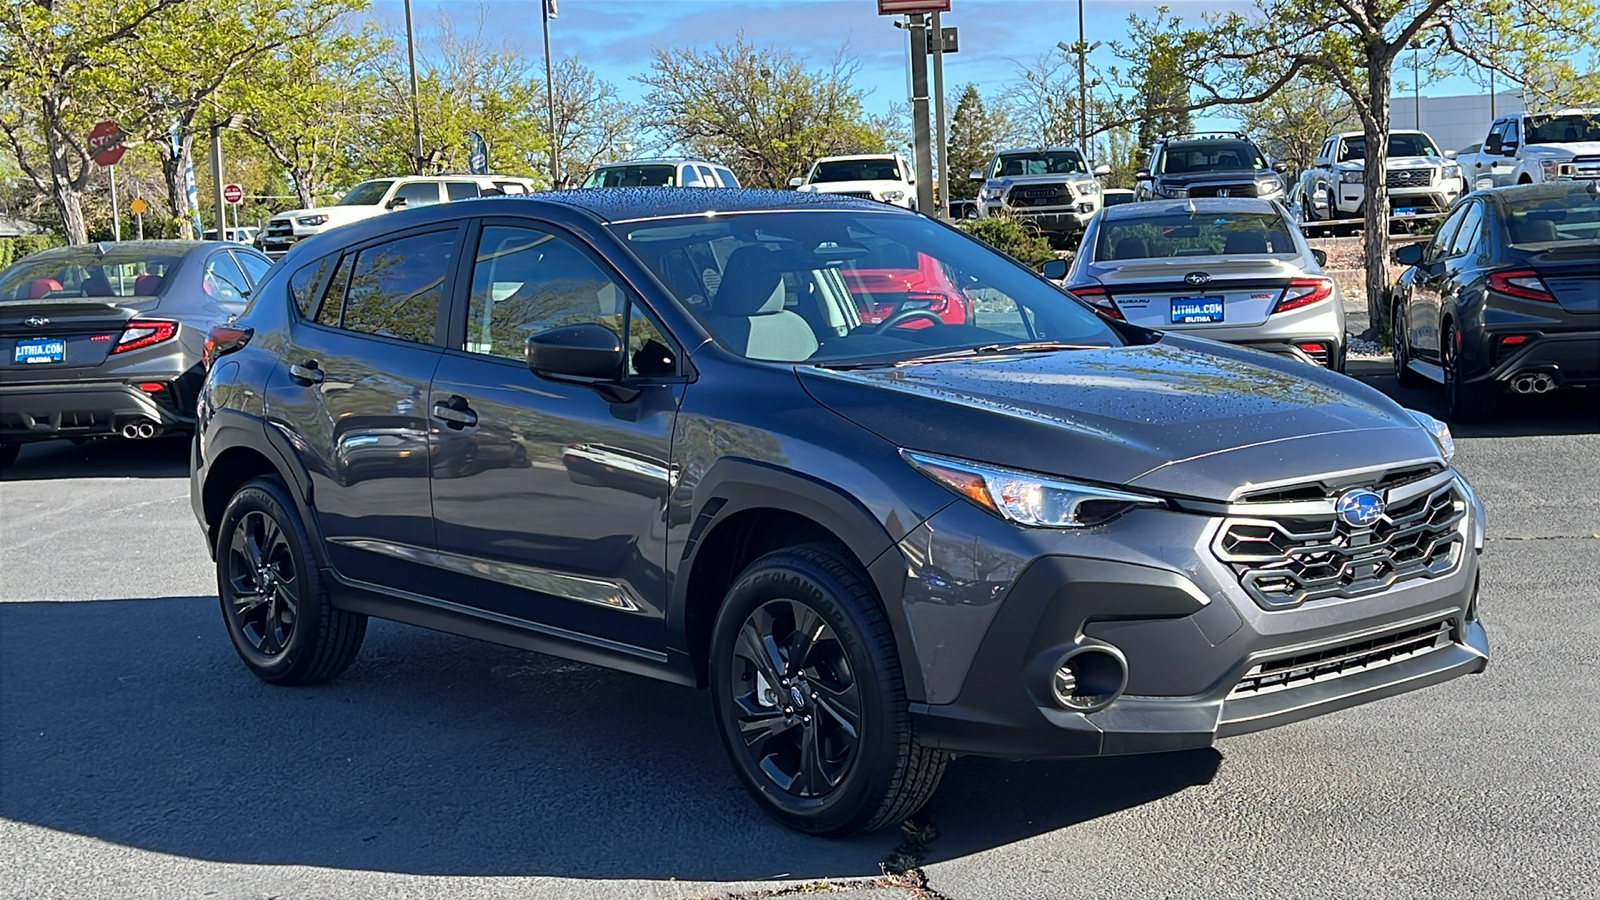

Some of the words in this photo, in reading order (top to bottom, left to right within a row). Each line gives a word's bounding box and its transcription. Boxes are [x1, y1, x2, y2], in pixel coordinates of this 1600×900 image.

[1027, 189, 1055, 197] TOYOTA
[1172, 303, 1222, 315] LITHIA.COM
[15, 342, 63, 356] LITHIA.COM
